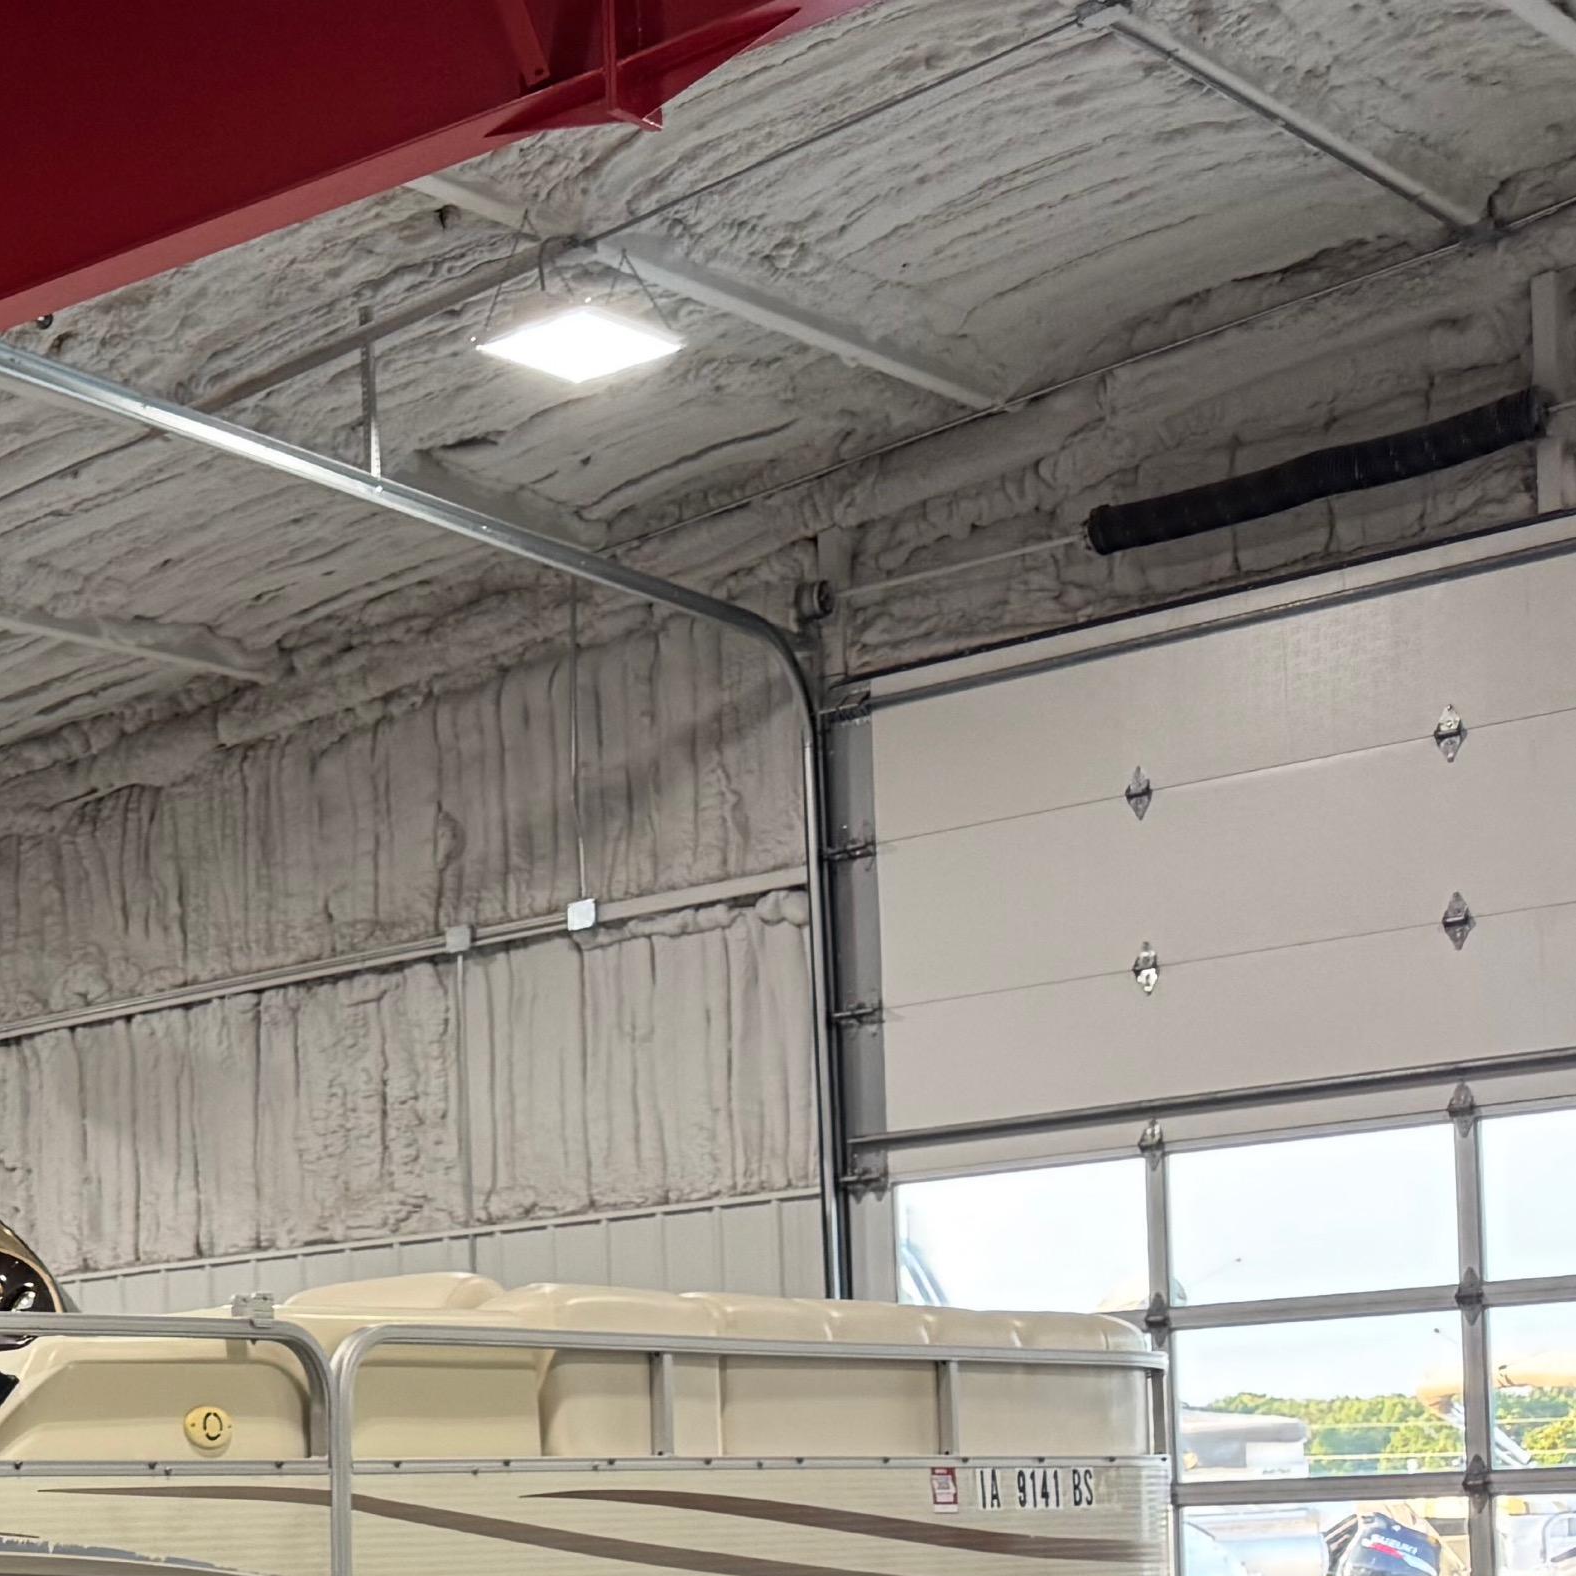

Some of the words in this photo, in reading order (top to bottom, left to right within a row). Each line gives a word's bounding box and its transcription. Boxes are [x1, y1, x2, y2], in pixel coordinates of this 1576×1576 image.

[980, 1469, 1001, 1509] IA
[1017, 1469, 1060, 1508] 9141
[1072, 1468, 1094, 1506] BS
